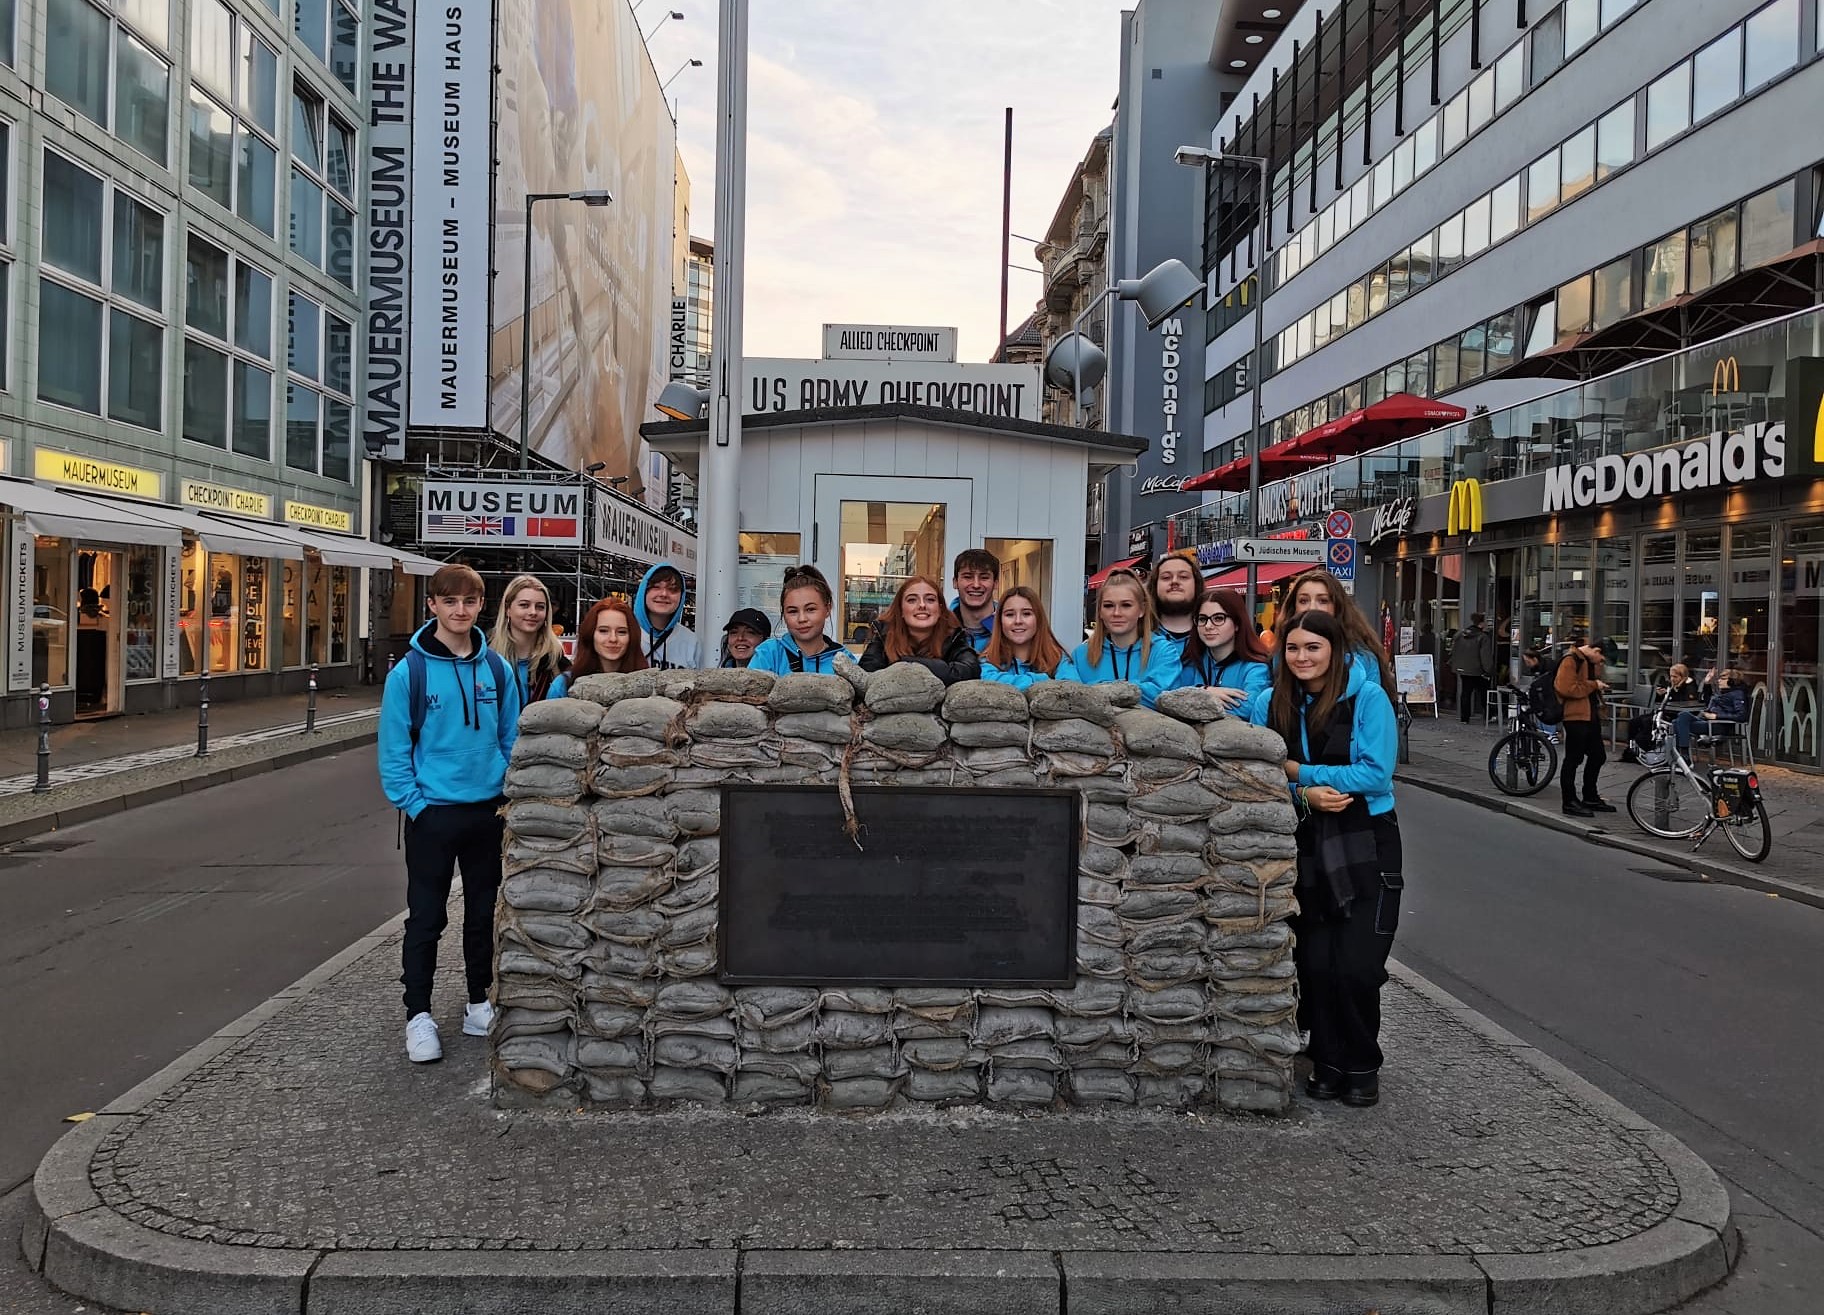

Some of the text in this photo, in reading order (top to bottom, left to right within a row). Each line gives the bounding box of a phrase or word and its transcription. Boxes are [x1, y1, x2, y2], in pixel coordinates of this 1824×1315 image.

[445, 6, 462, 70] HAUS
[371, 62, 405, 127] THE
[443, 82, 461, 187] MUSEUM
[367, 146, 405, 446] MAUERMUSEUM
[441, 219, 459, 409] MAUERMUSEUM
[671, 300, 686, 369] CHARLIE
[840, 330, 940, 352] ALLIED CHECKPOINT
[752, 376, 787, 412] US
[800, 378, 869, 410] ARMY
[1161, 317, 1183, 464] McDonald's
[63, 460, 138, 492] MAUERMUSEUM
[1140, 474, 1192, 496] McCaf
[1542, 420, 1786, 513] McDonald's
[188, 484, 263, 514] CHECKPOINT CHARLIE
[289, 505, 345, 528] CHECKPOINT CHARLIE
[428, 489, 577, 514] MUSEUM
[1258, 483, 1287, 526] NACKS
[1298, 467, 1336, 518] COFFEE
[1370, 496, 1414, 542] McCafé
[601, 502, 669, 558] MAUERMUSEUM
[1258, 544, 1321, 556] Jüdisches Museum
[17, 542, 27, 652] MUSEUMTICKETS
[1328, 566, 1352, 577] TAXI
